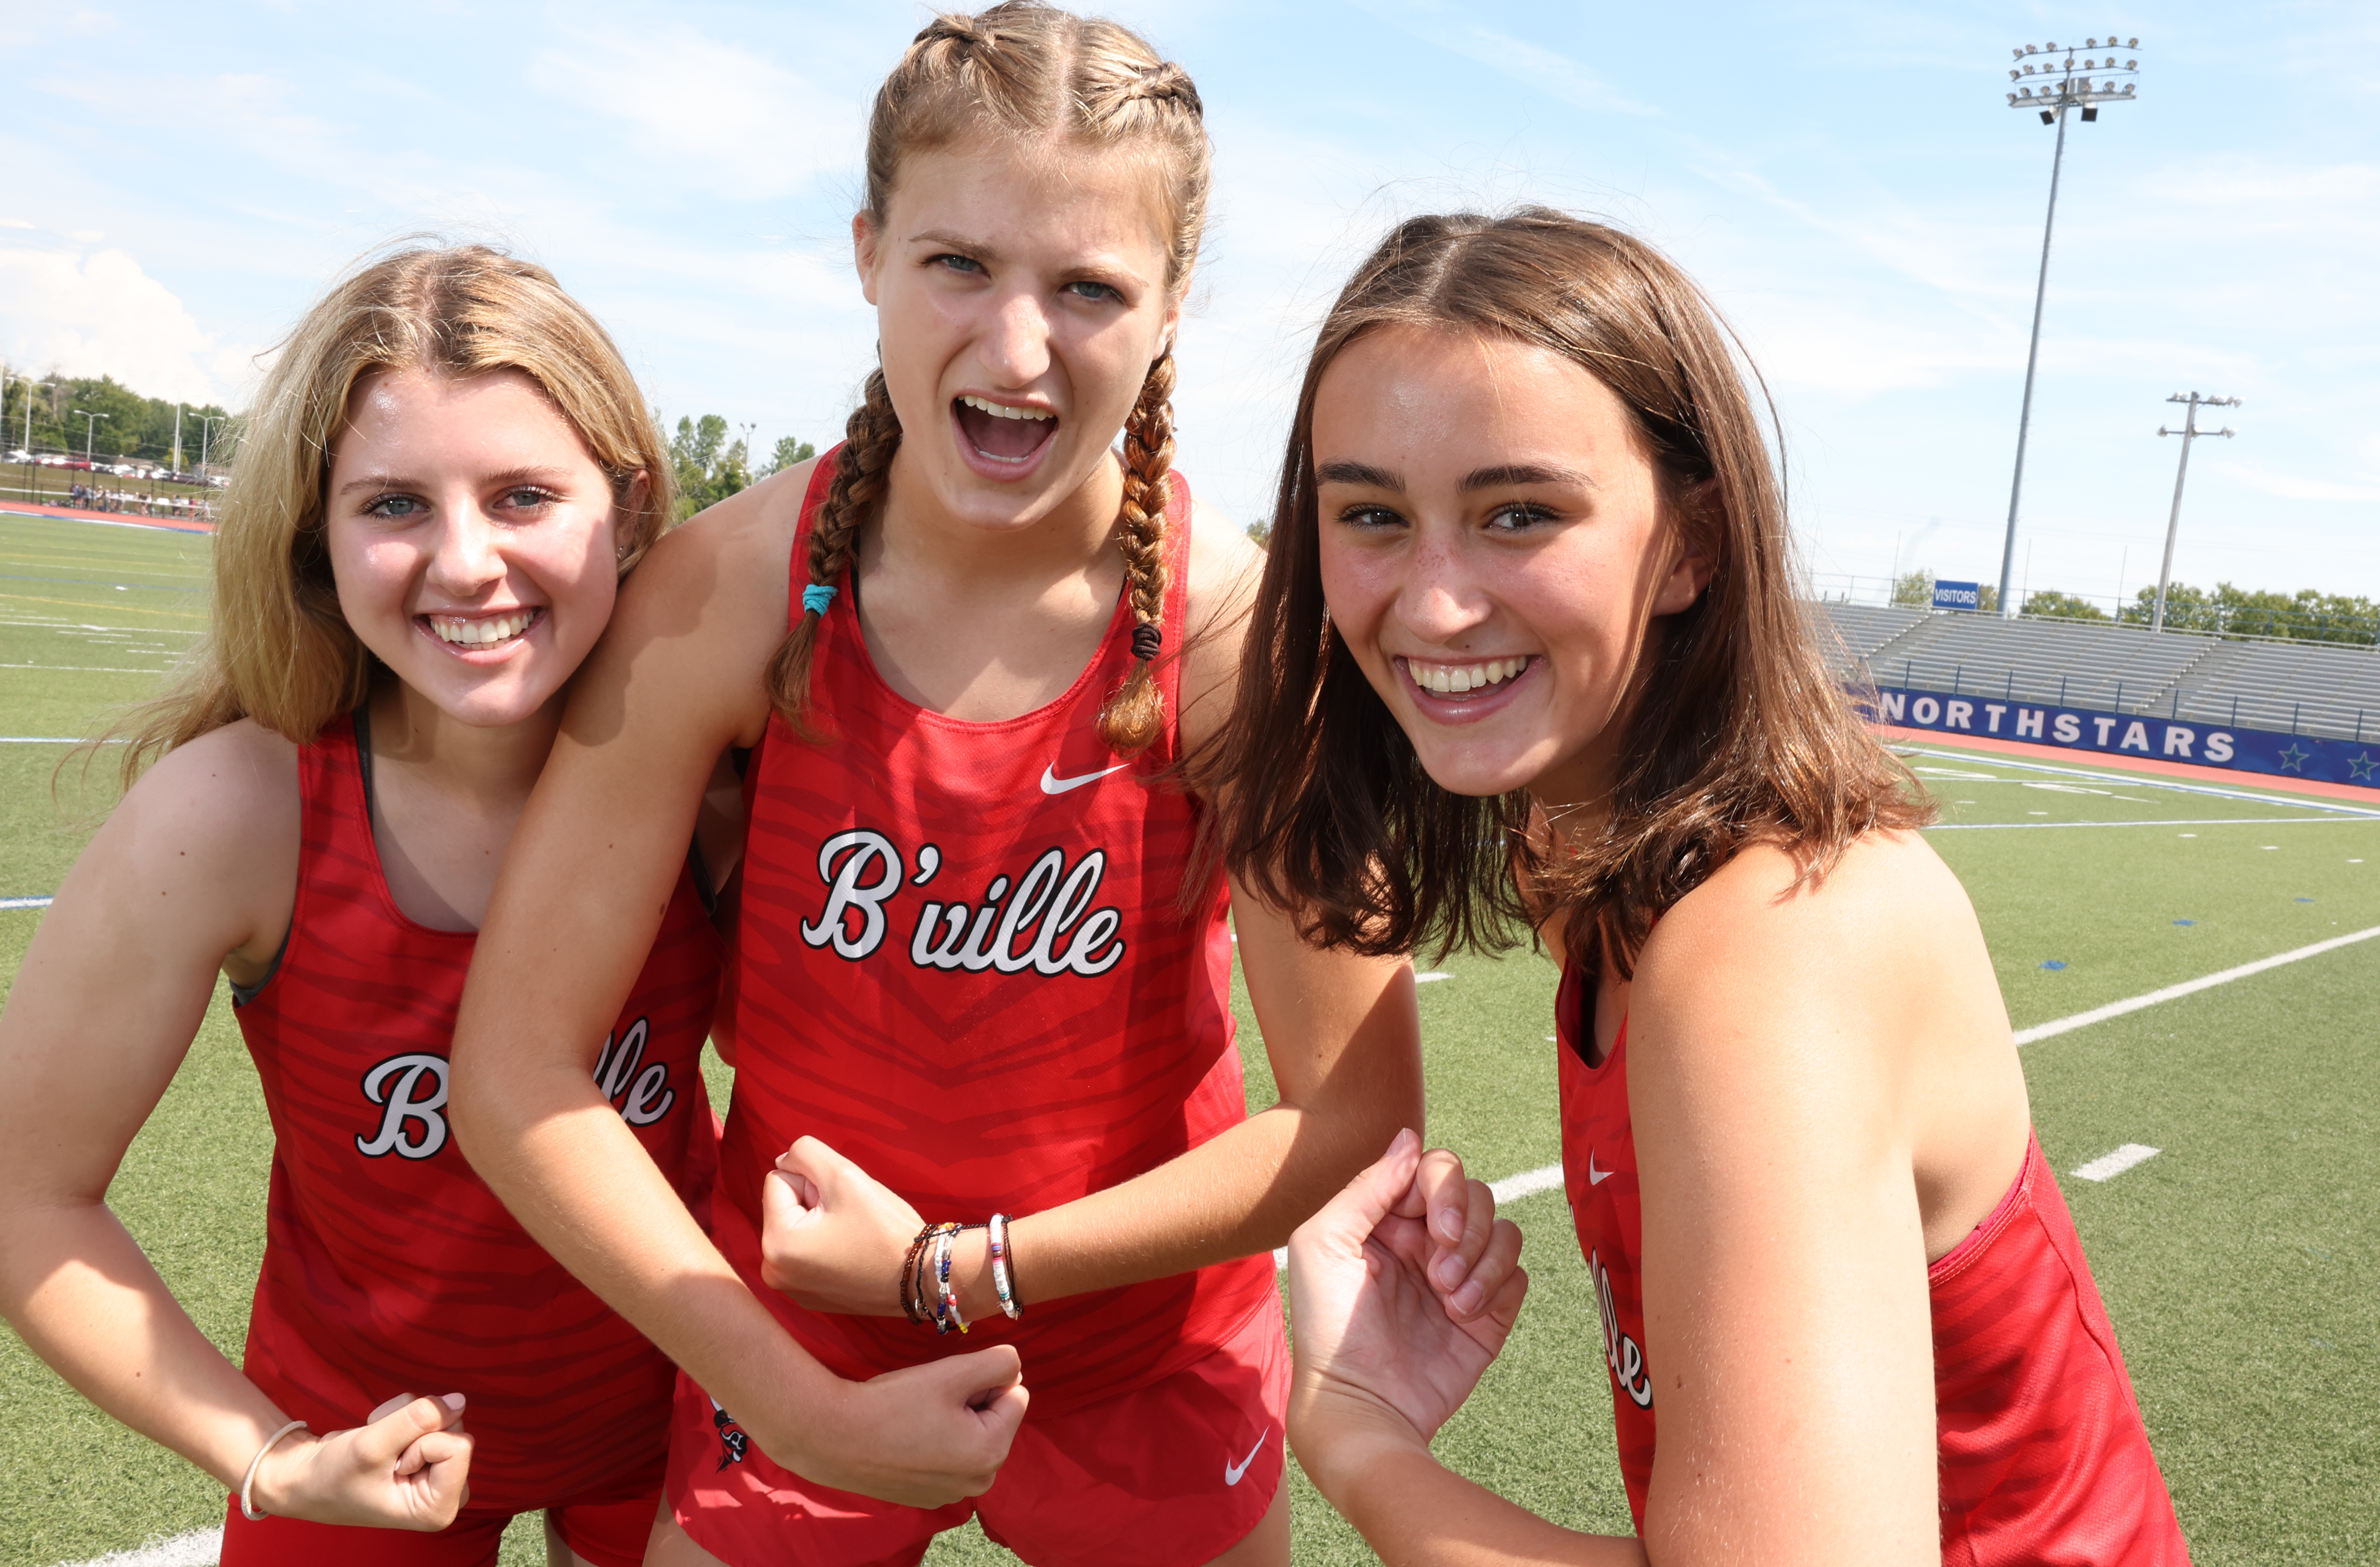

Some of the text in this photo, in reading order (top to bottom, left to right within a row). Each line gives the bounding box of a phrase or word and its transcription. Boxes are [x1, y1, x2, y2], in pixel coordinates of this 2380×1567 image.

[1935, 588, 1976, 604] VISITORS
[1881, 692, 2234, 762] NORTHSTARS
[800, 828, 1126, 978] B'ville
